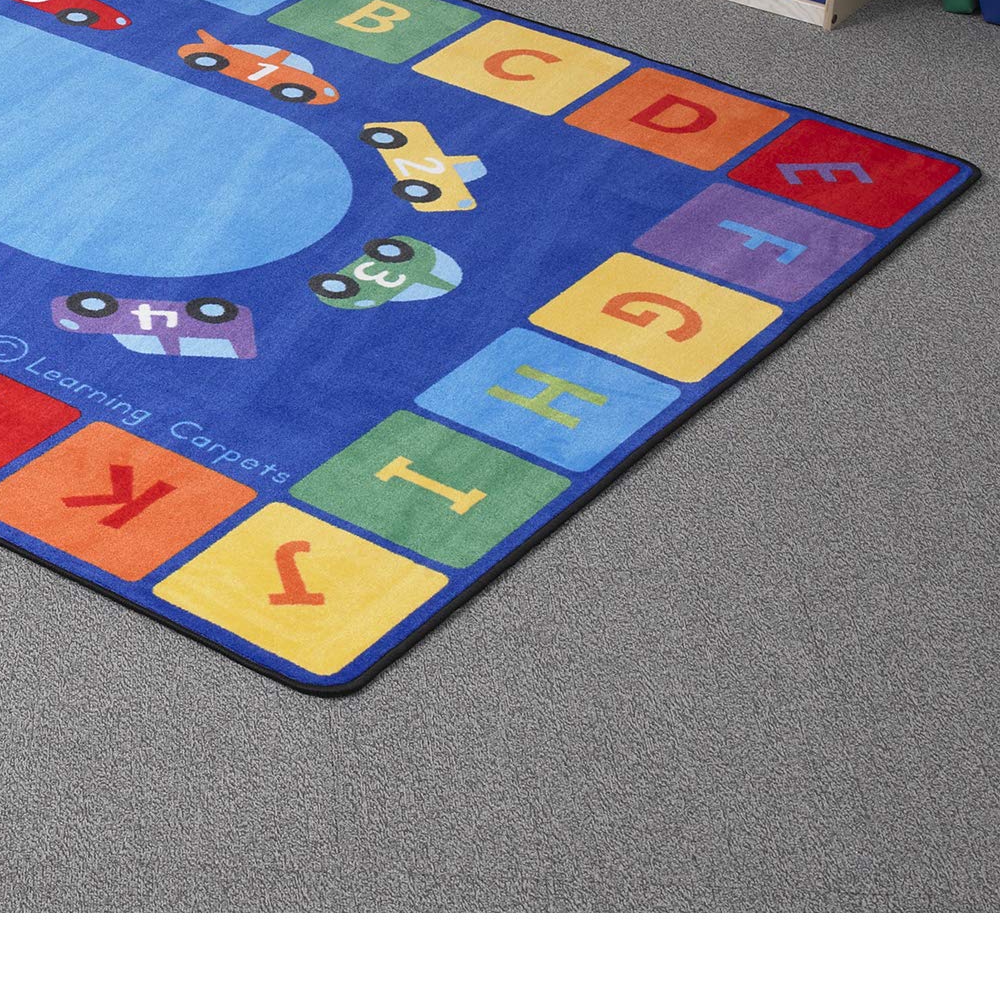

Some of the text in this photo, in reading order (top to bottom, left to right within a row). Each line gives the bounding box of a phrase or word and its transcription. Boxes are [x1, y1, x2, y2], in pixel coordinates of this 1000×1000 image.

[334, 0, 411, 33] B
[248, 62, 280, 81] 1
[483, 48, 562, 82] C
[629, 93, 717, 134] D
[392, 157, 446, 177] 2
[775, 161, 873, 186] E
[718, 219, 808, 265] F
[355, 261, 406, 289] 3
[130, 303, 177, 333] 4
[601, 291, 703, 342] G
[486, 364, 608, 429] H
[24, 355, 153, 428] Learning
[169, 420, 290, 486] Carpets
[61, 464, 177, 529] K
[374, 456, 487, 515] I
[268, 540, 325, 606] J
